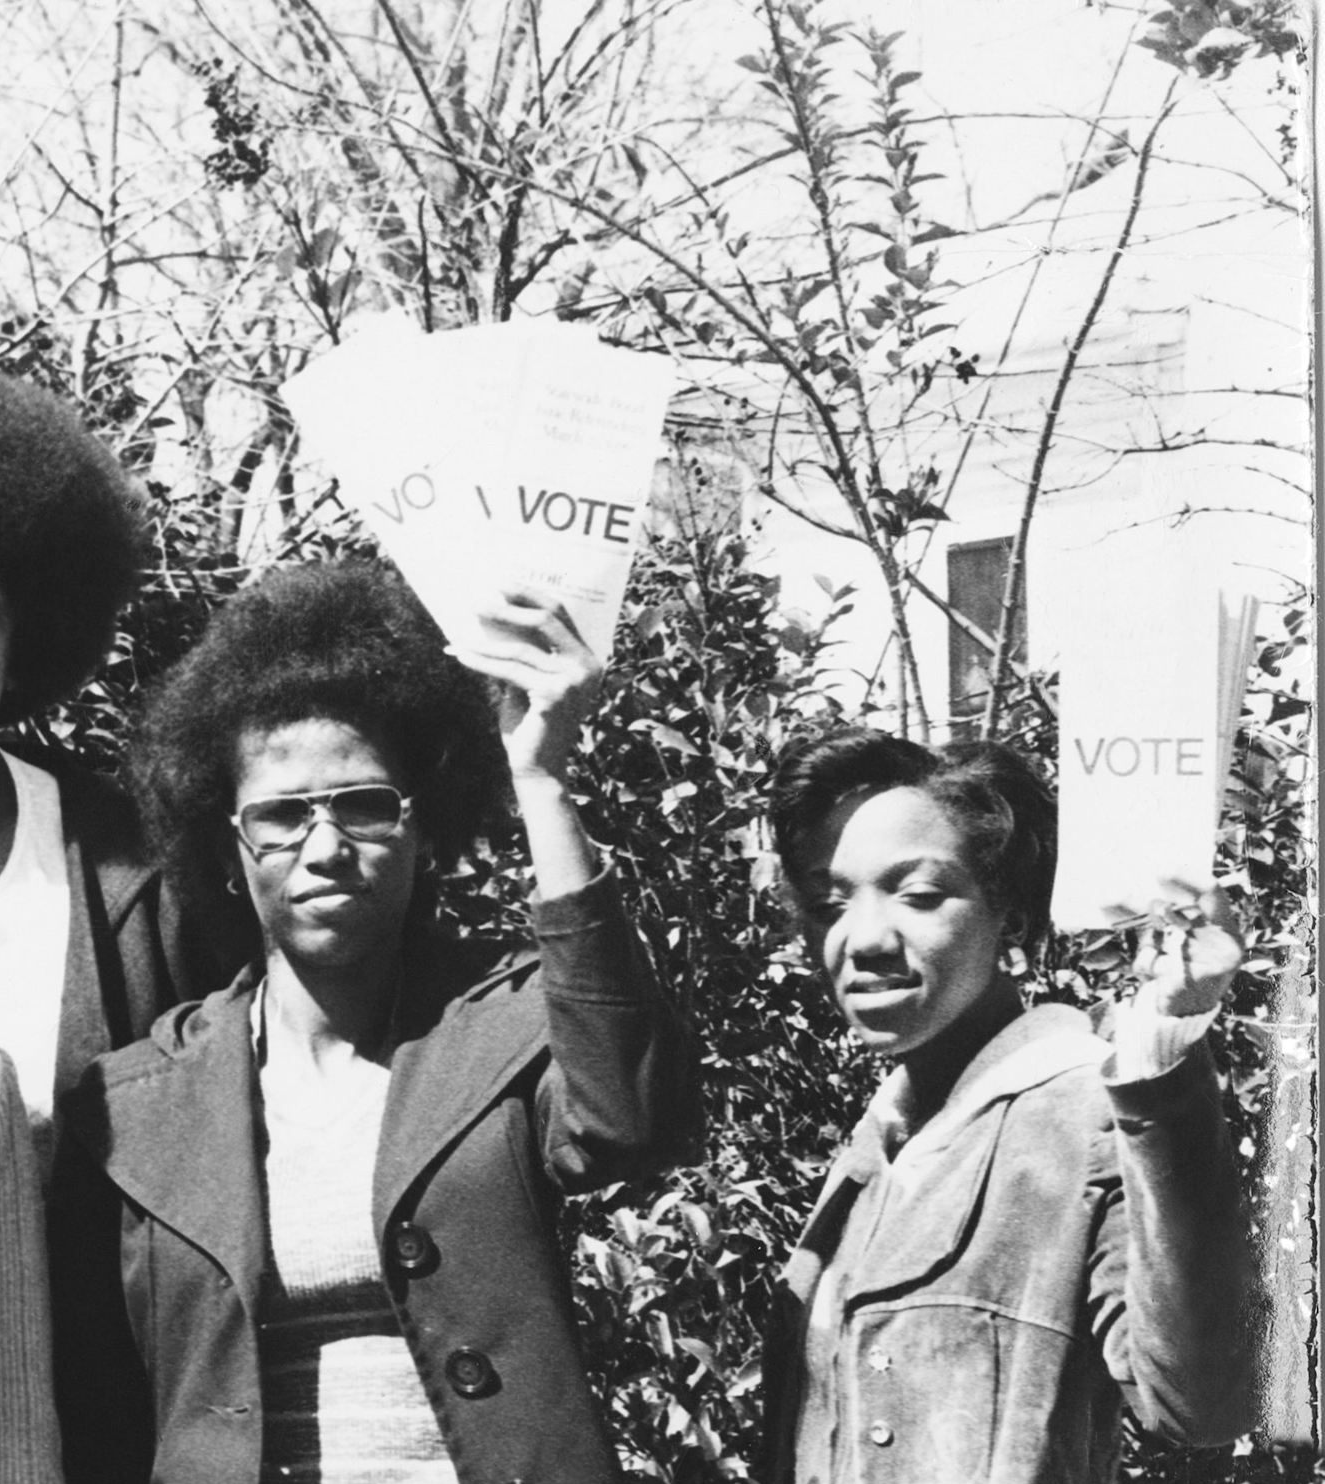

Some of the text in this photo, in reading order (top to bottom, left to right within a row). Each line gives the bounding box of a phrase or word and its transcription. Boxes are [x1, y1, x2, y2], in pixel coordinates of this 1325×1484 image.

[371, 472, 436, 525] VO
[517, 485, 636, 544] VOTE
[1073, 736, 1204, 777] VOTE
